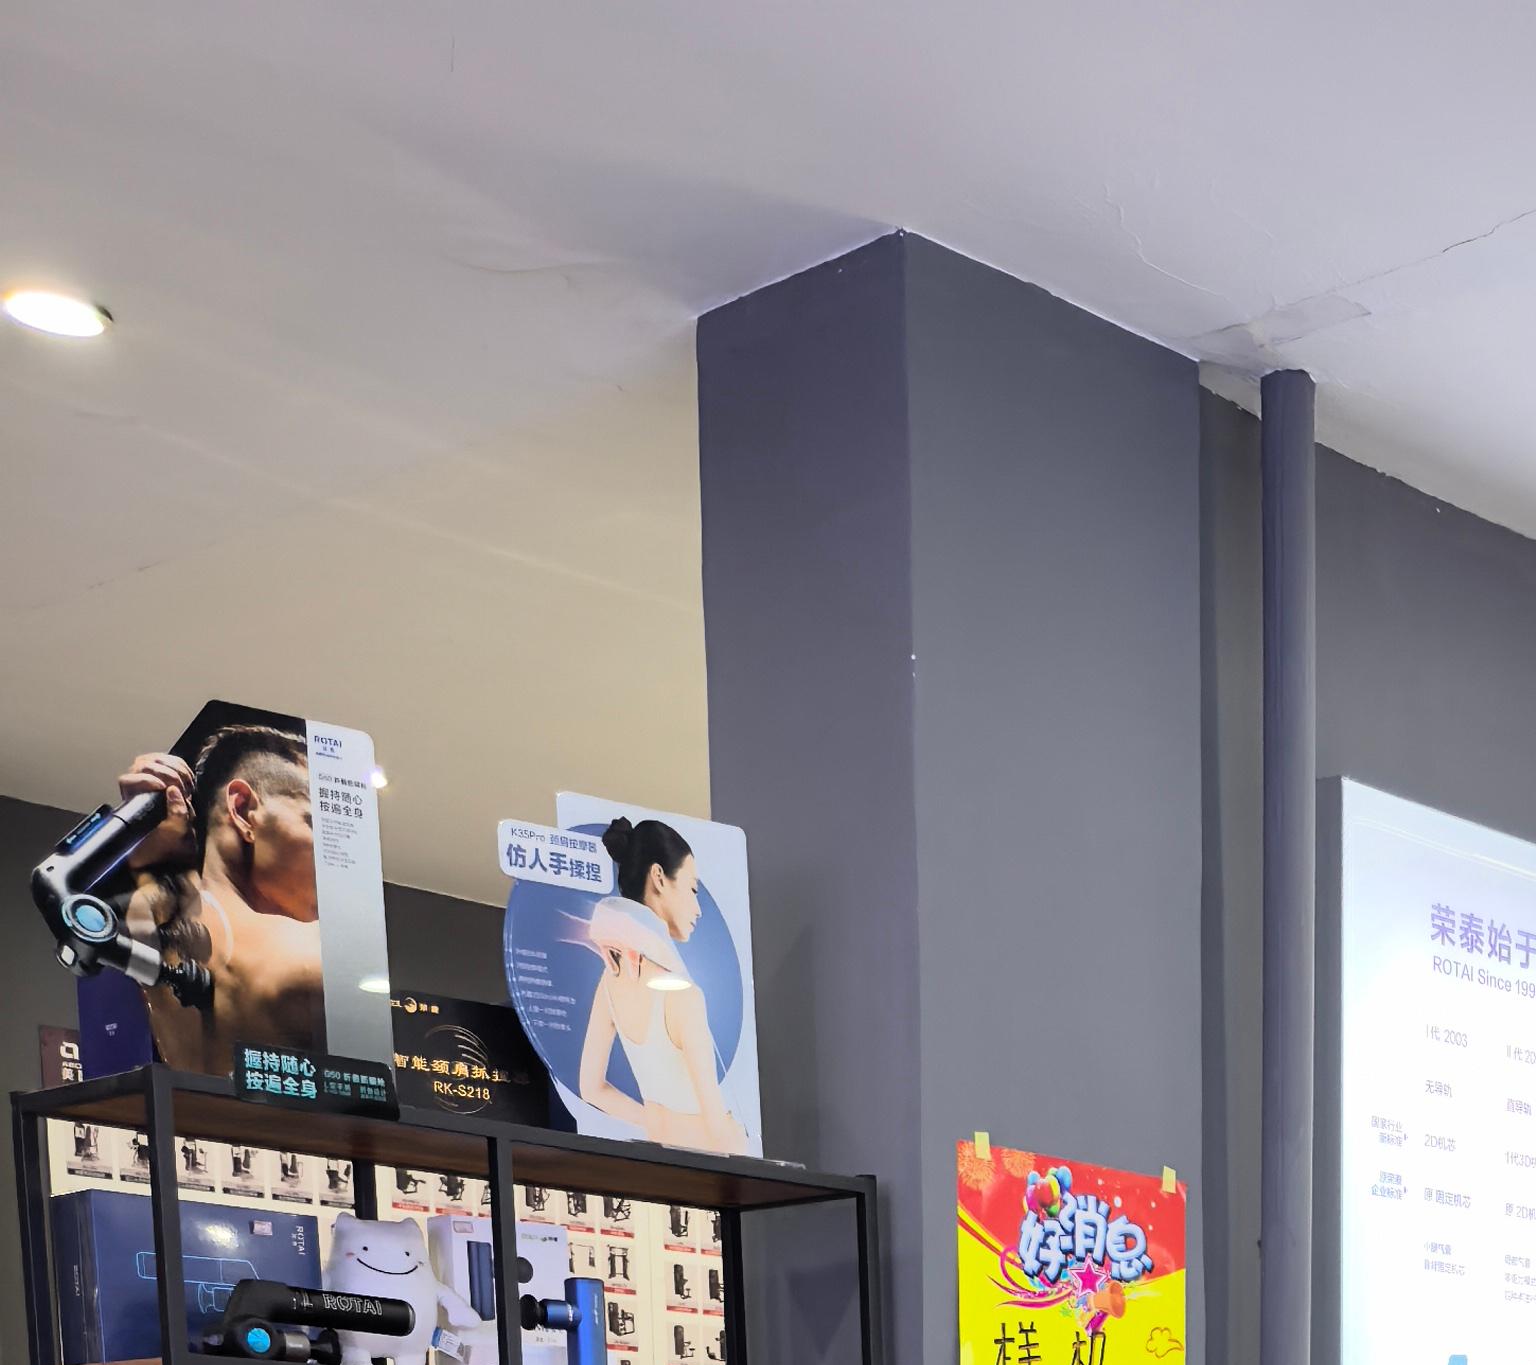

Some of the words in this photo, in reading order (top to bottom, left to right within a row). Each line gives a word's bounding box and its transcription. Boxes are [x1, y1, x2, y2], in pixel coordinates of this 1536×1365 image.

[506, 843, 602, 882] 仿人手揉捏
[1433, 955, 1474, 983] ROTAI
[1478, 968, 1511, 993] Since
[244, 1048, 316, 1077] 握持随心
[245, 1071, 318, 1099] 按遍全身
[433, 1081, 490, 1100] RK-S218
[1019, 1193, 1154, 1282] 好消息
[323, 1293, 382, 1316] ROTAI
